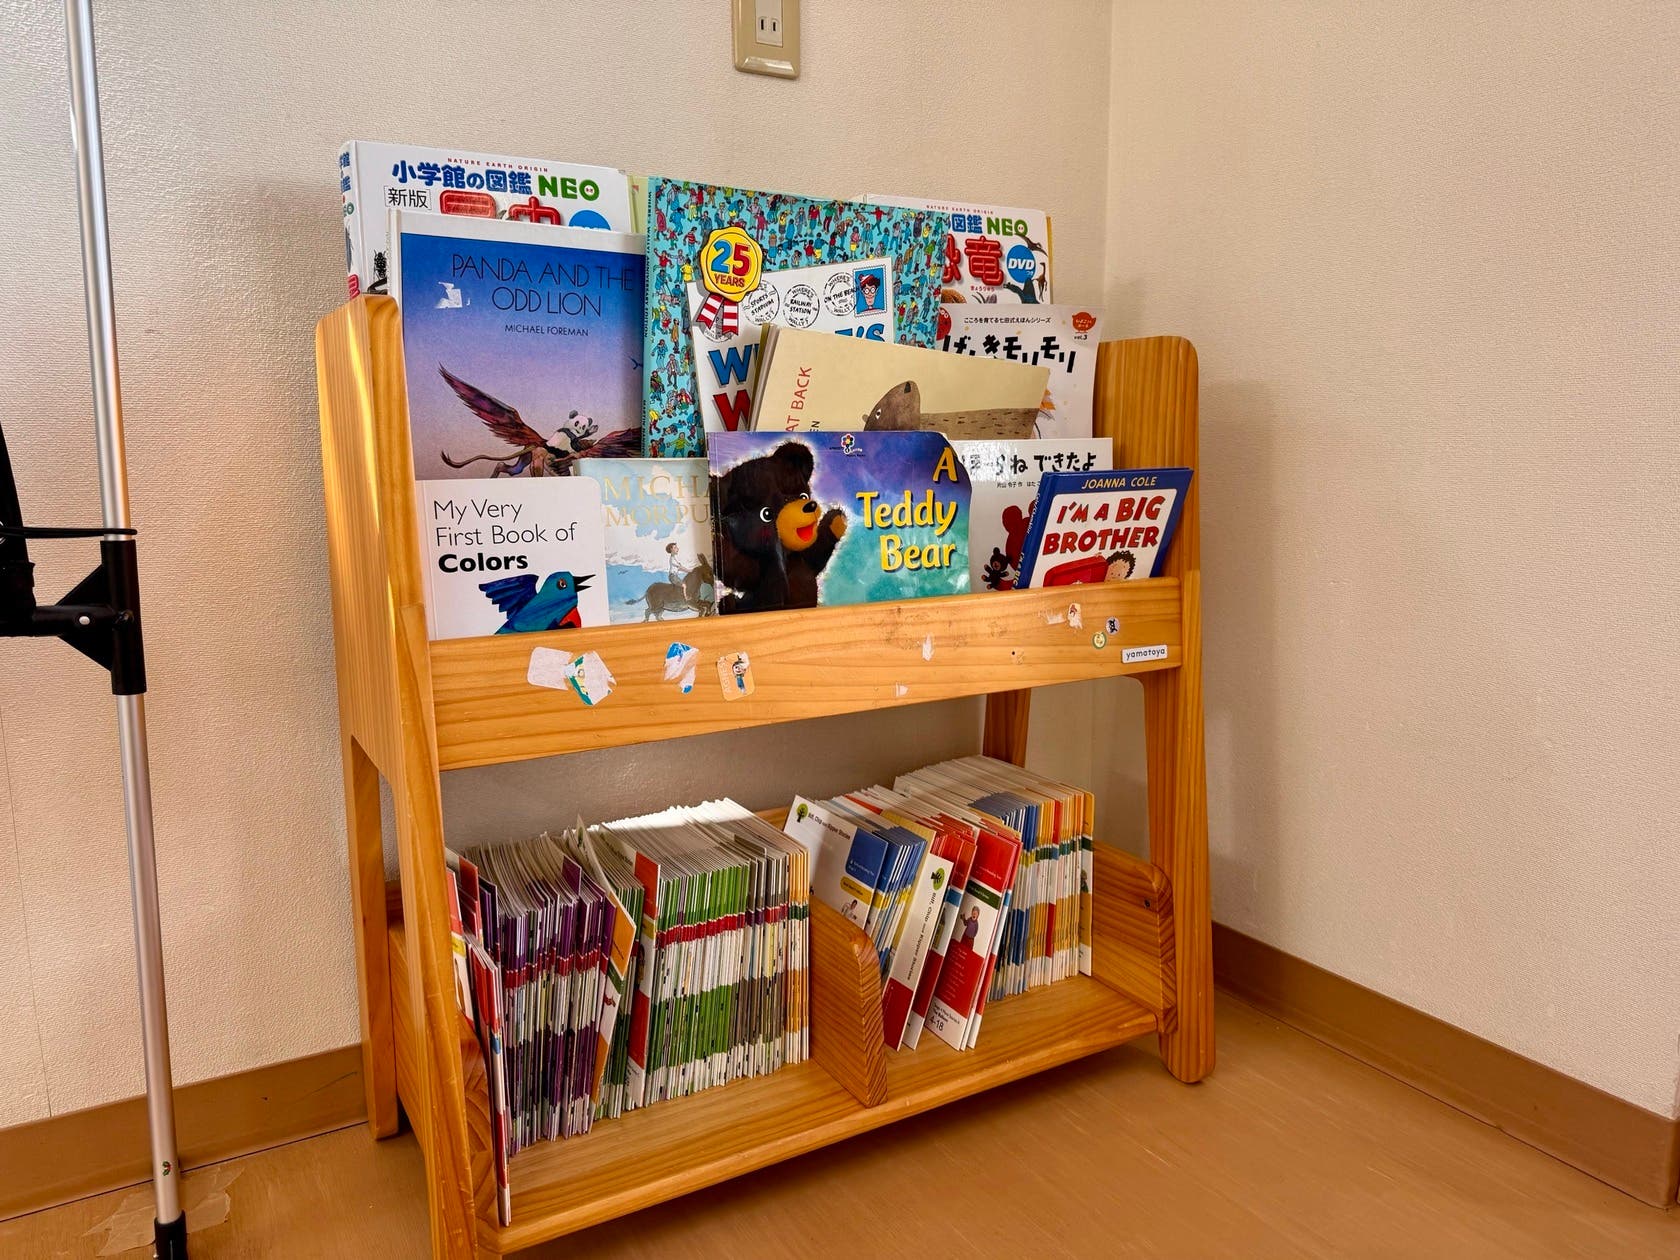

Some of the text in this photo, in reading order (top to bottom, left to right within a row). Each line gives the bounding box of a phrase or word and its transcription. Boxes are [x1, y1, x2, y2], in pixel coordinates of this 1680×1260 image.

[447, 157, 548, 173] NATURE EARTH ORIGIN
[392, 159, 600, 202] 小学館の図鑑 NEO
[388, 187, 429, 209] 新版
[986, 217, 1028, 236] NEO
[710, 239, 751, 276] 25
[1008, 258, 1035, 270] DVD
[452, 254, 634, 291] PANDA AND THE
[714, 274, 745, 288] YEARS
[492, 287, 601, 318] ODD LION
[750, 293, 769, 308] SPORTS
[790, 299, 812, 307] RAILWAY
[832, 291, 843, 300] THE
[751, 299, 775, 316] STADIUM
[789, 307, 811, 315] STATION
[504, 324, 589, 337] MICHAEL FOREMAN
[791, 366, 813, 410] BACK
[933, 446, 958, 483] A
[1033, 452, 1097, 472] できたよ
[1081, 476, 1158, 490] JOANNA COLE
[433, 498, 522, 524] My Very
[856, 489, 957, 537] Teddy
[1056, 495, 1166, 524] I'M A BIG
[436, 522, 578, 547] First Book of
[1042, 526, 1160, 556] BROTHER
[438, 553, 529, 573] Colors
[879, 534, 956, 572] Bear
[1126, 647, 1166, 660] yamatoya
